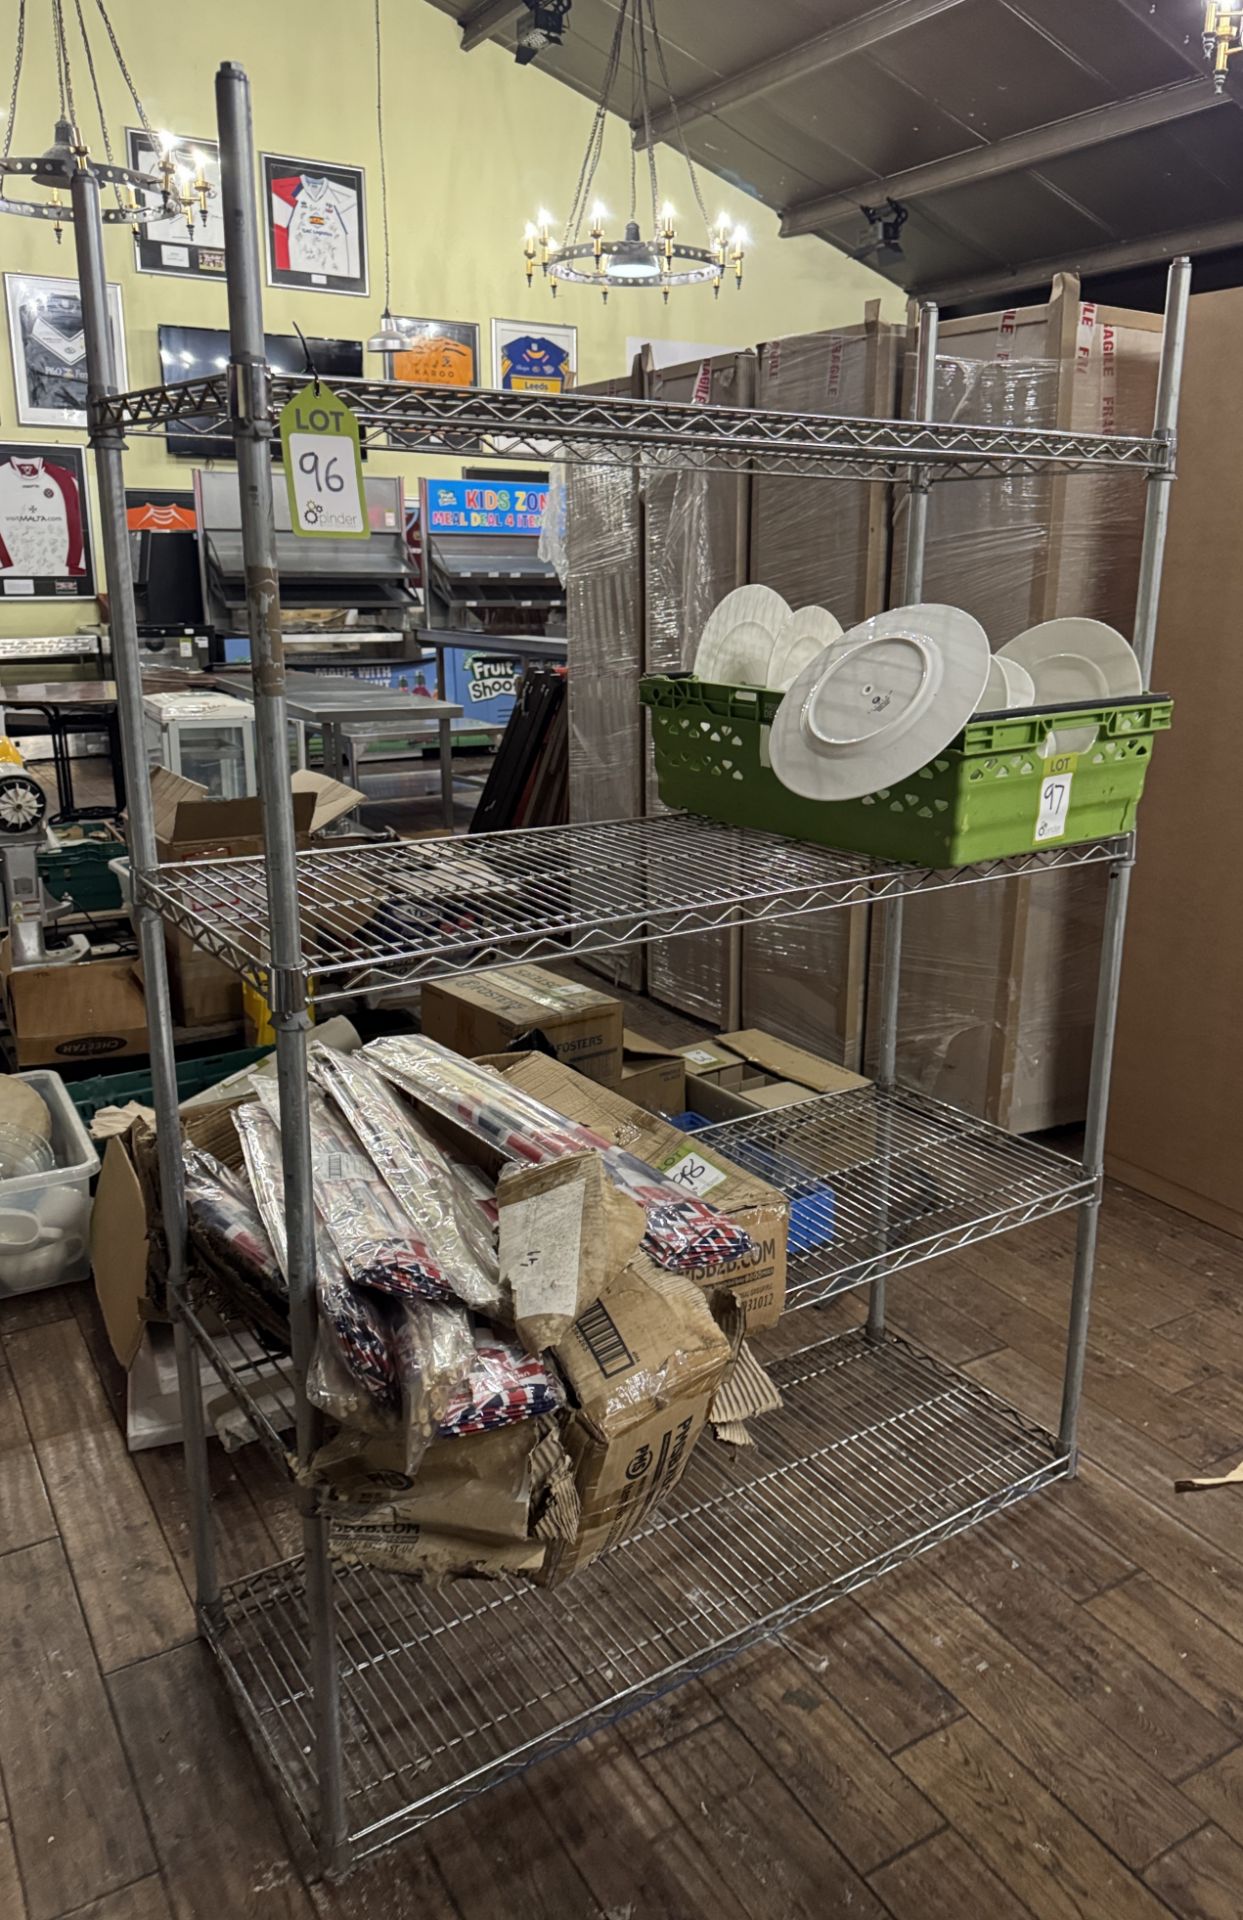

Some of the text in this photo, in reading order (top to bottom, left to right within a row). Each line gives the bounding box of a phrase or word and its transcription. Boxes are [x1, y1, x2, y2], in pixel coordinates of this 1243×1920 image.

[525, 381, 548, 390] Leeds
[295, 408, 345, 432] LOT
[298, 451, 345, 493] 96
[465, 490, 510, 511] KIDS
[319, 512, 357, 525] pinder
[432, 512, 468, 526] MEAL
[470, 512, 503, 527] DEAL
[505, 514, 515, 527] 4
[473, 661, 514, 680] Fruit
[471, 680, 516, 699] Shoo
[1050, 757, 1070, 772] LOT
[1043, 783, 1065, 815] 97
[63, 1040, 119, 1053] CHEETAH
[556, 1034, 604, 1053] FOSTERS
[659, 1151, 682, 1169] LOT
[632, 1443, 651, 1472] PMS
